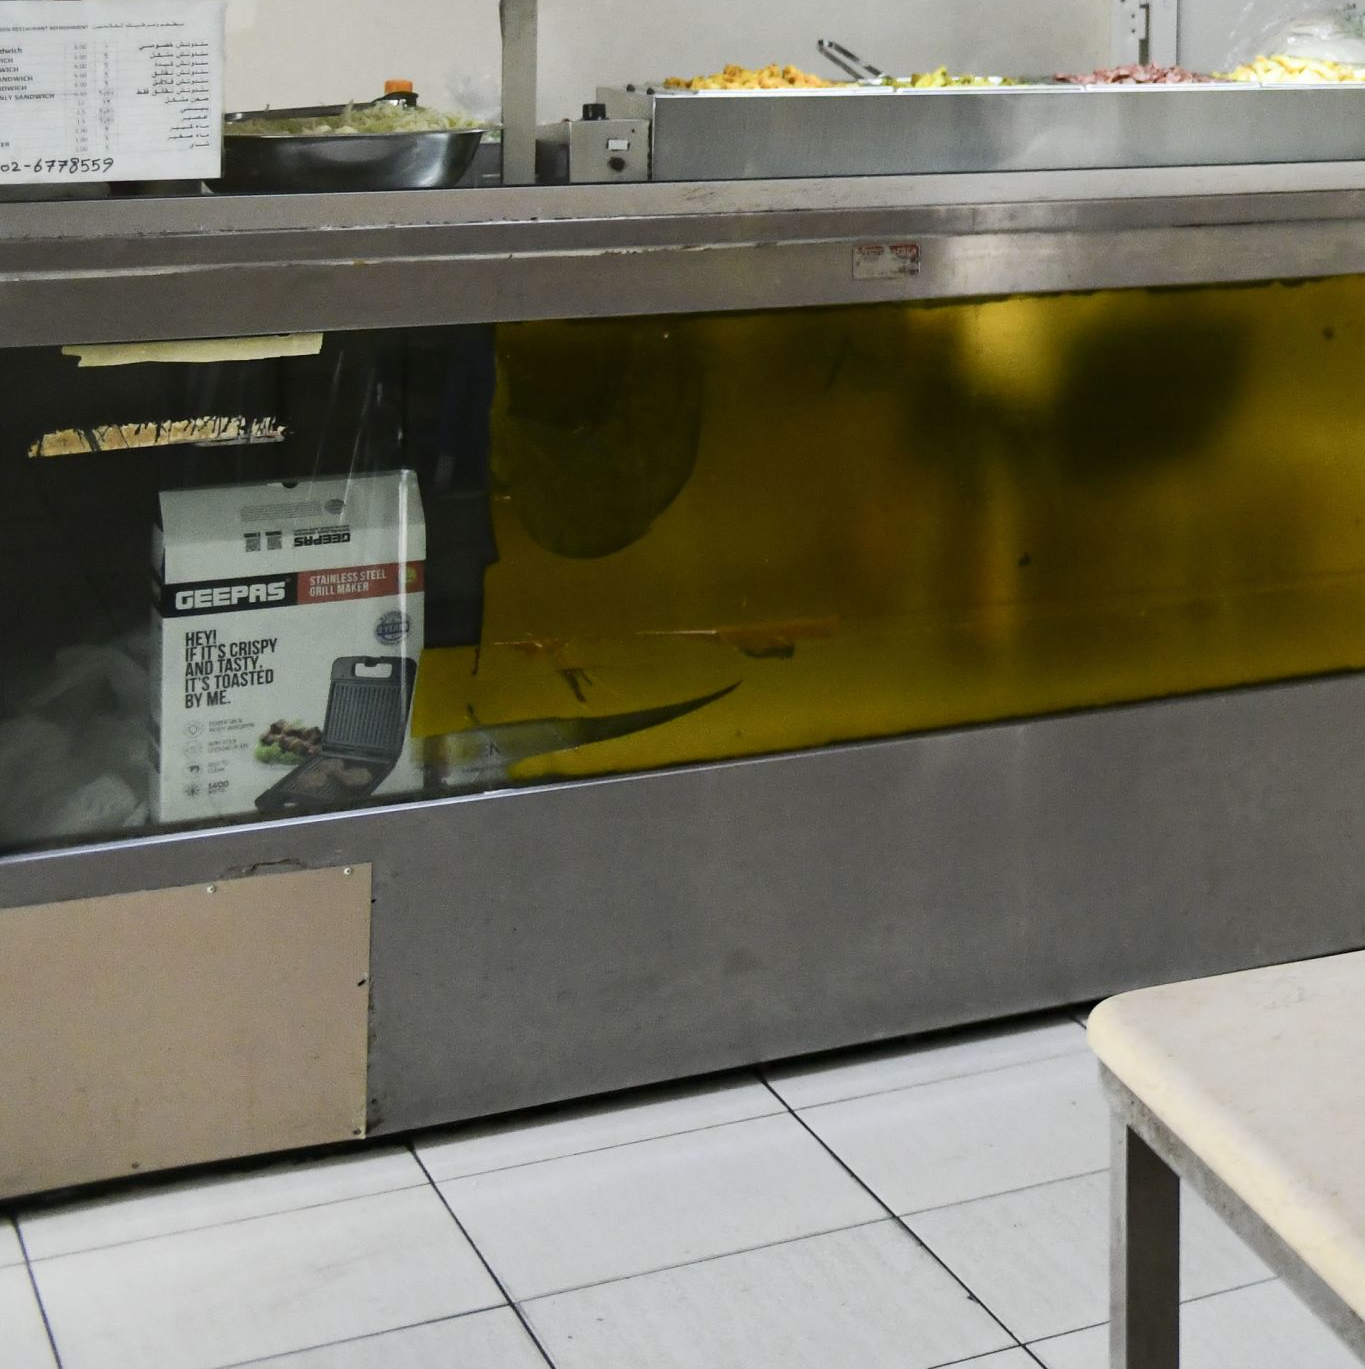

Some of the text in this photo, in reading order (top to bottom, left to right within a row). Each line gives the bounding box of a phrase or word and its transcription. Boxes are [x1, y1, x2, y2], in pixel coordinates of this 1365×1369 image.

[0, 157, 115, 174] 02-6778559
[294, 532, 350, 547] GEEPAS
[309, 568, 387, 586] STAINLESS STEEL
[175, 581, 286, 611] GEEPAS
[309, 582, 370, 597] GRILL MAKER
[185, 629, 217, 647] HEY!
[185, 638, 278, 663] IF IT'S CRISPY
[185, 660, 214, 677] AND
[185, 669, 274, 693] IT'S TOASTED
[185, 690, 232, 709] BY ME.
